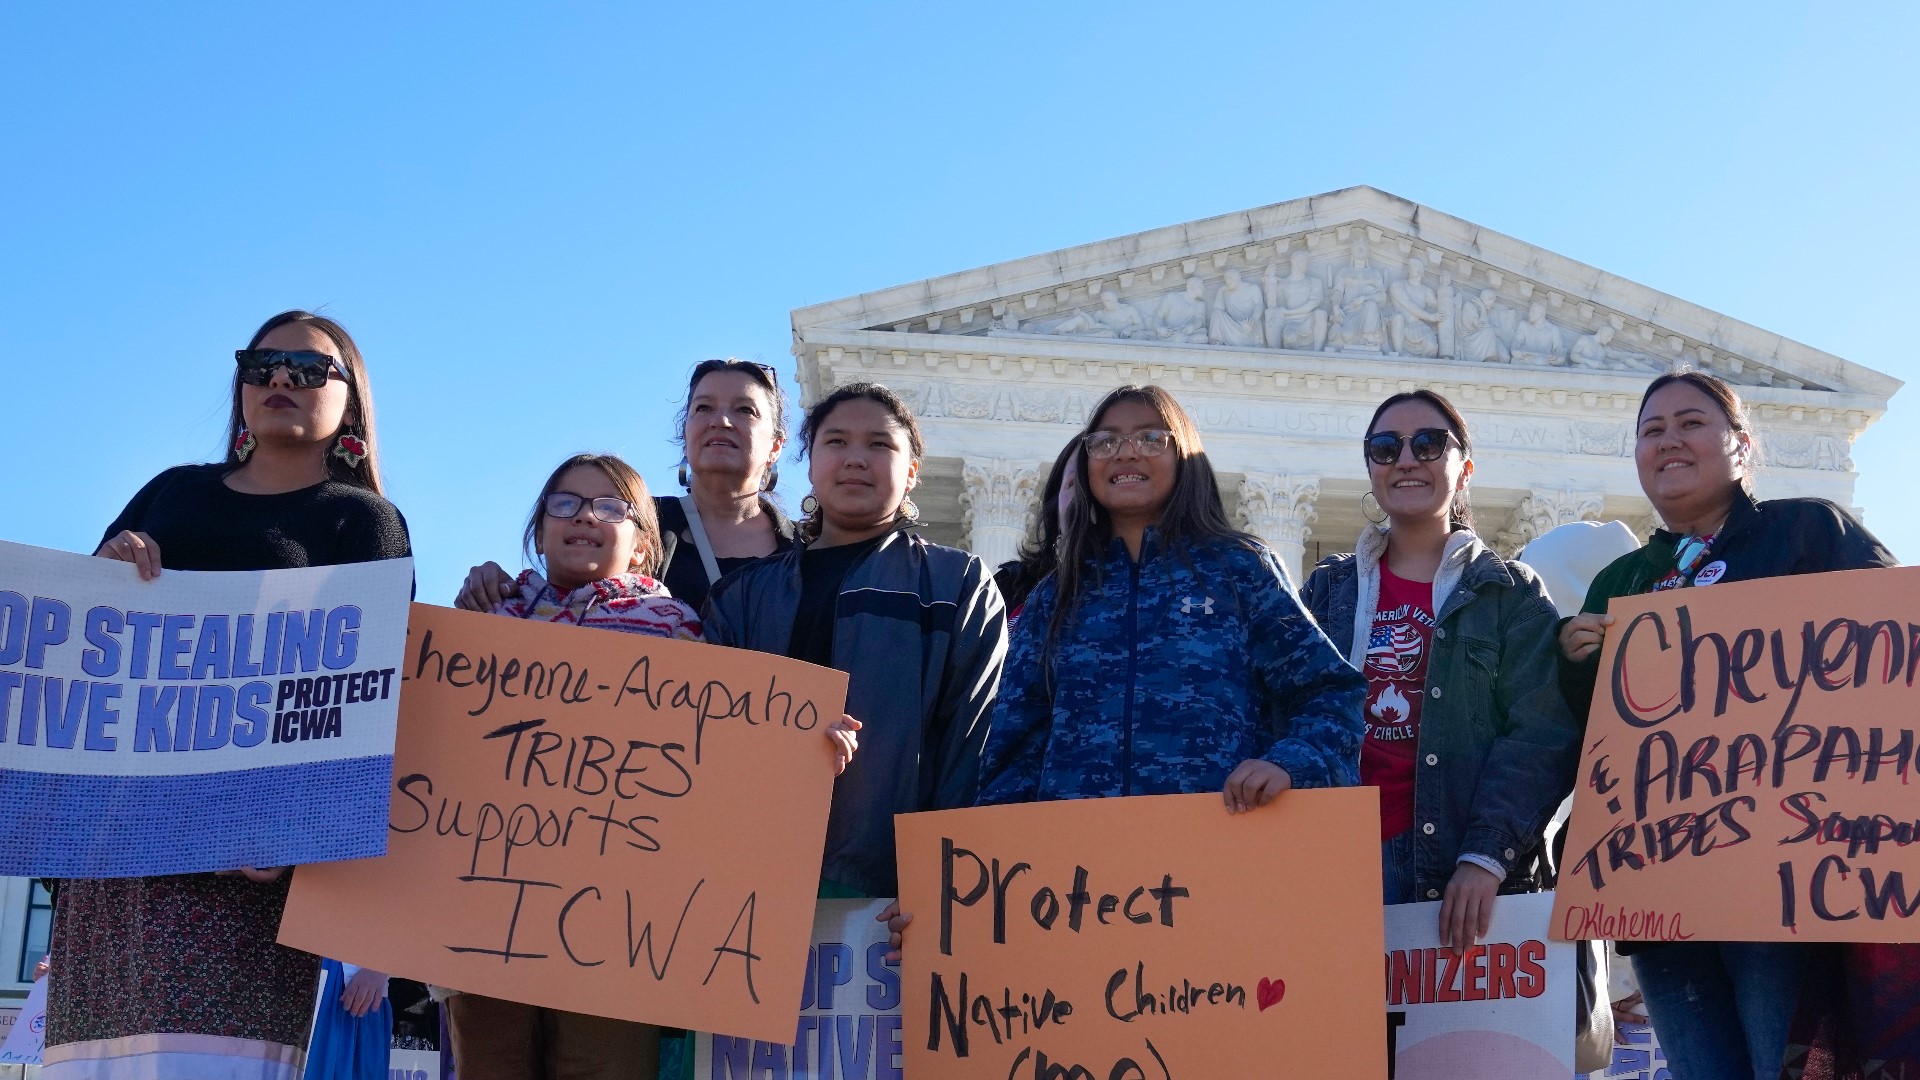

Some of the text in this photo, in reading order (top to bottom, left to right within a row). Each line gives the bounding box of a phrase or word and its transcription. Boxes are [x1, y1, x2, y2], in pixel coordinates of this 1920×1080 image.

[1270, 407, 1365, 434] JUSTIC
[81, 604, 363, 681] STEALING
[133, 680, 274, 753] KIDS
[271, 706, 342, 744] ICWA
[275, 668, 396, 712] PROTECT
[402, 628, 818, 764] heyenne-Arapaho
[482, 718, 692, 799] TRIBES
[1373, 724, 1414, 740] CIRCLE
[1634, 724, 1920, 821] ARAPAH
[388, 773, 660, 877] Supports
[1570, 796, 1755, 891] TRIBES
[940, 837, 1190, 956] Protect
[442, 878, 761, 1004] ICWA
[1385, 940, 1546, 1005] NIZERS
[711, 1015, 903, 1080] NATIVE
[927, 960, 1246, 1057] Native Children
